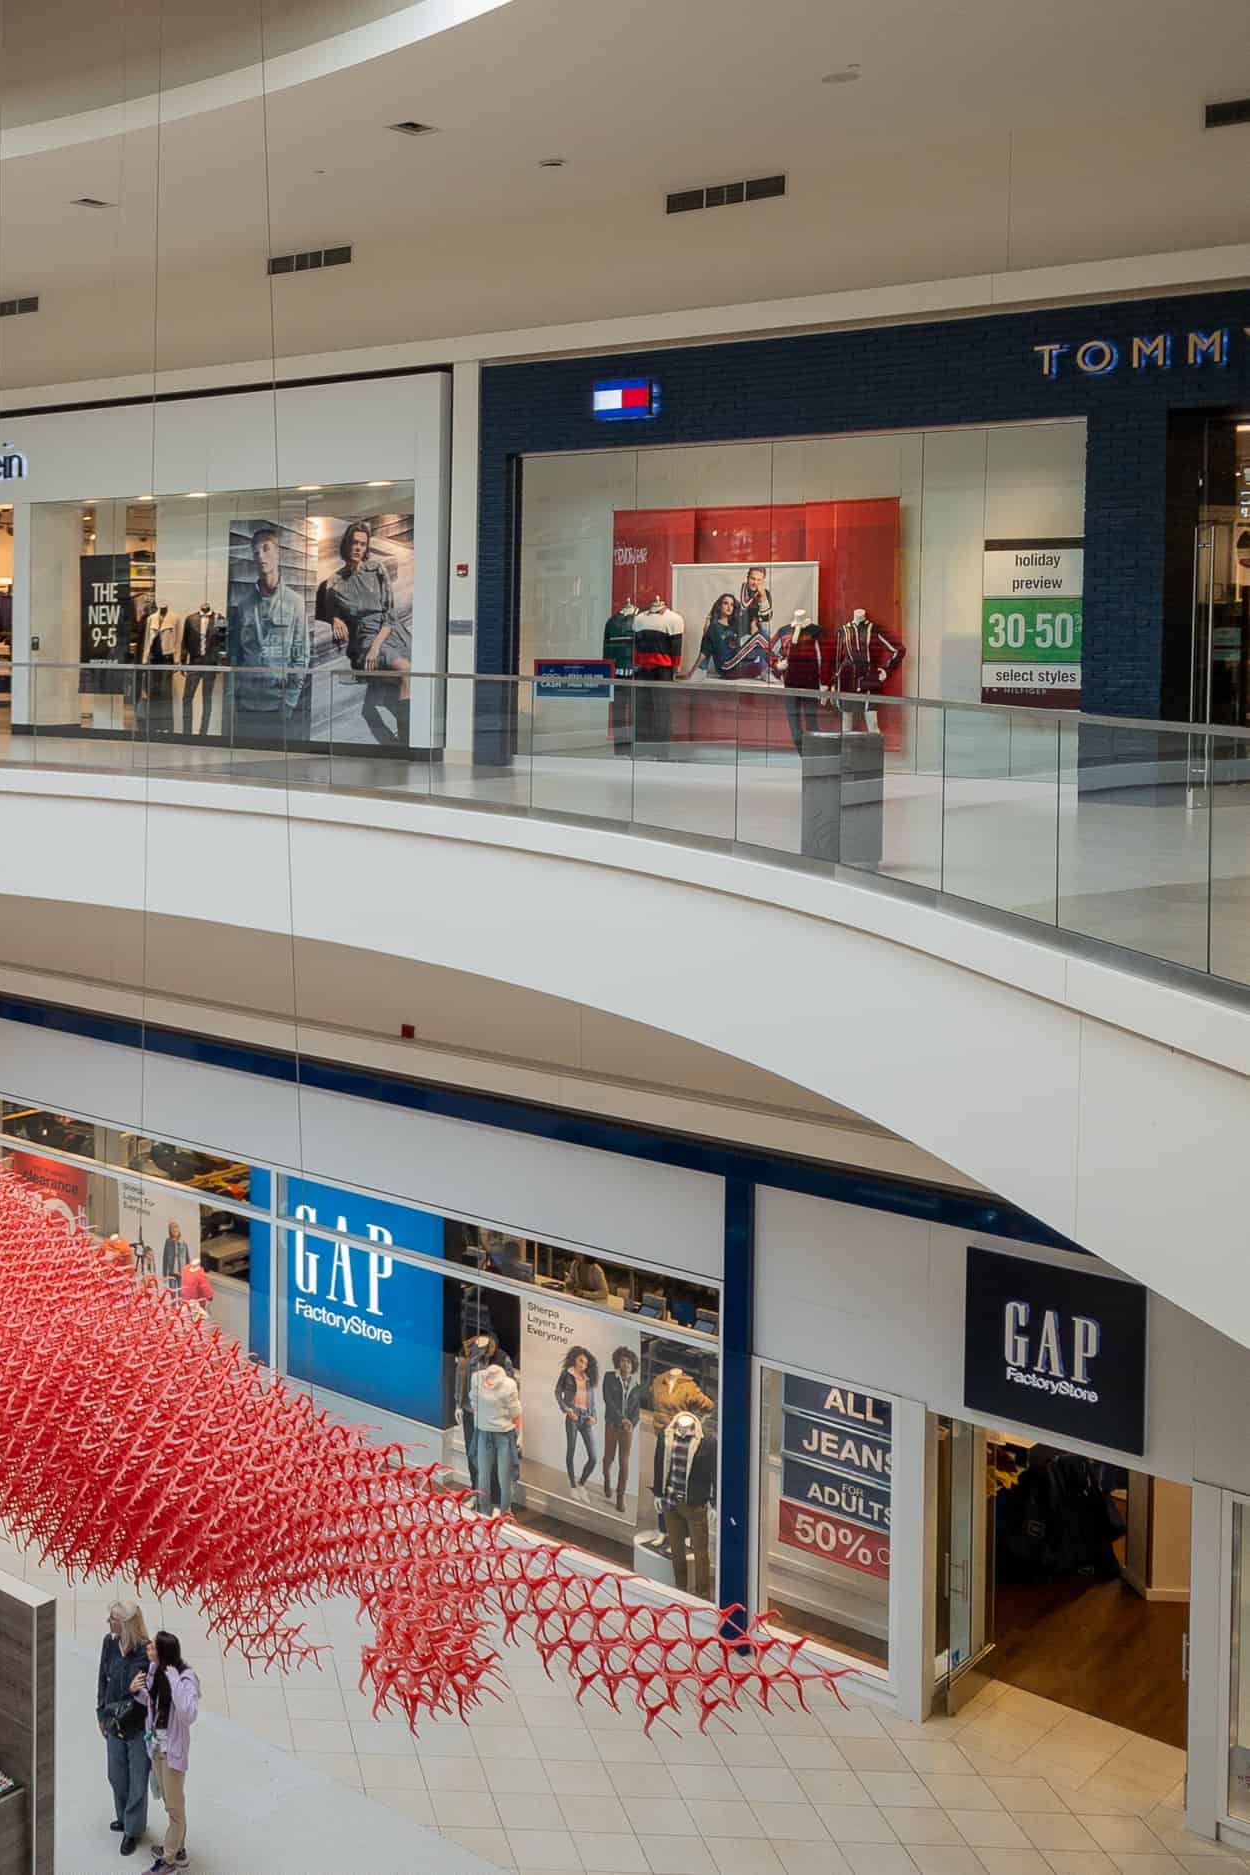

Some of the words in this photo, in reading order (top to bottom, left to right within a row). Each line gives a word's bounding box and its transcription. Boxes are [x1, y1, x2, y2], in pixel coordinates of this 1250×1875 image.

[1034, 328, 1250, 376] TOMM
[1014, 552, 1061, 568] holiday
[91, 582, 119, 603] THE
[1012, 576, 1063, 593] preview
[88, 604, 121, 625] NEW
[91, 627, 118, 648] 9-5
[995, 669, 1034, 683] select
[1037, 670, 1077, 685] styles
[295, 1204, 393, 1316] GAP
[527, 1301, 559, 1319] Sherpa
[295, 1297, 393, 1345] FactoryStore
[527, 1312, 557, 1330] Layers
[559, 1322, 575, 1335] For
[527, 1324, 568, 1345] Everyone
[1005, 1301, 1100, 1384] GAP
[1006, 1366, 1099, 1403] FactoryStore
[823, 1387, 884, 1426] ALL
[841, 1483, 864, 1497] FOR
[794, 1512, 873, 1566] 50%
